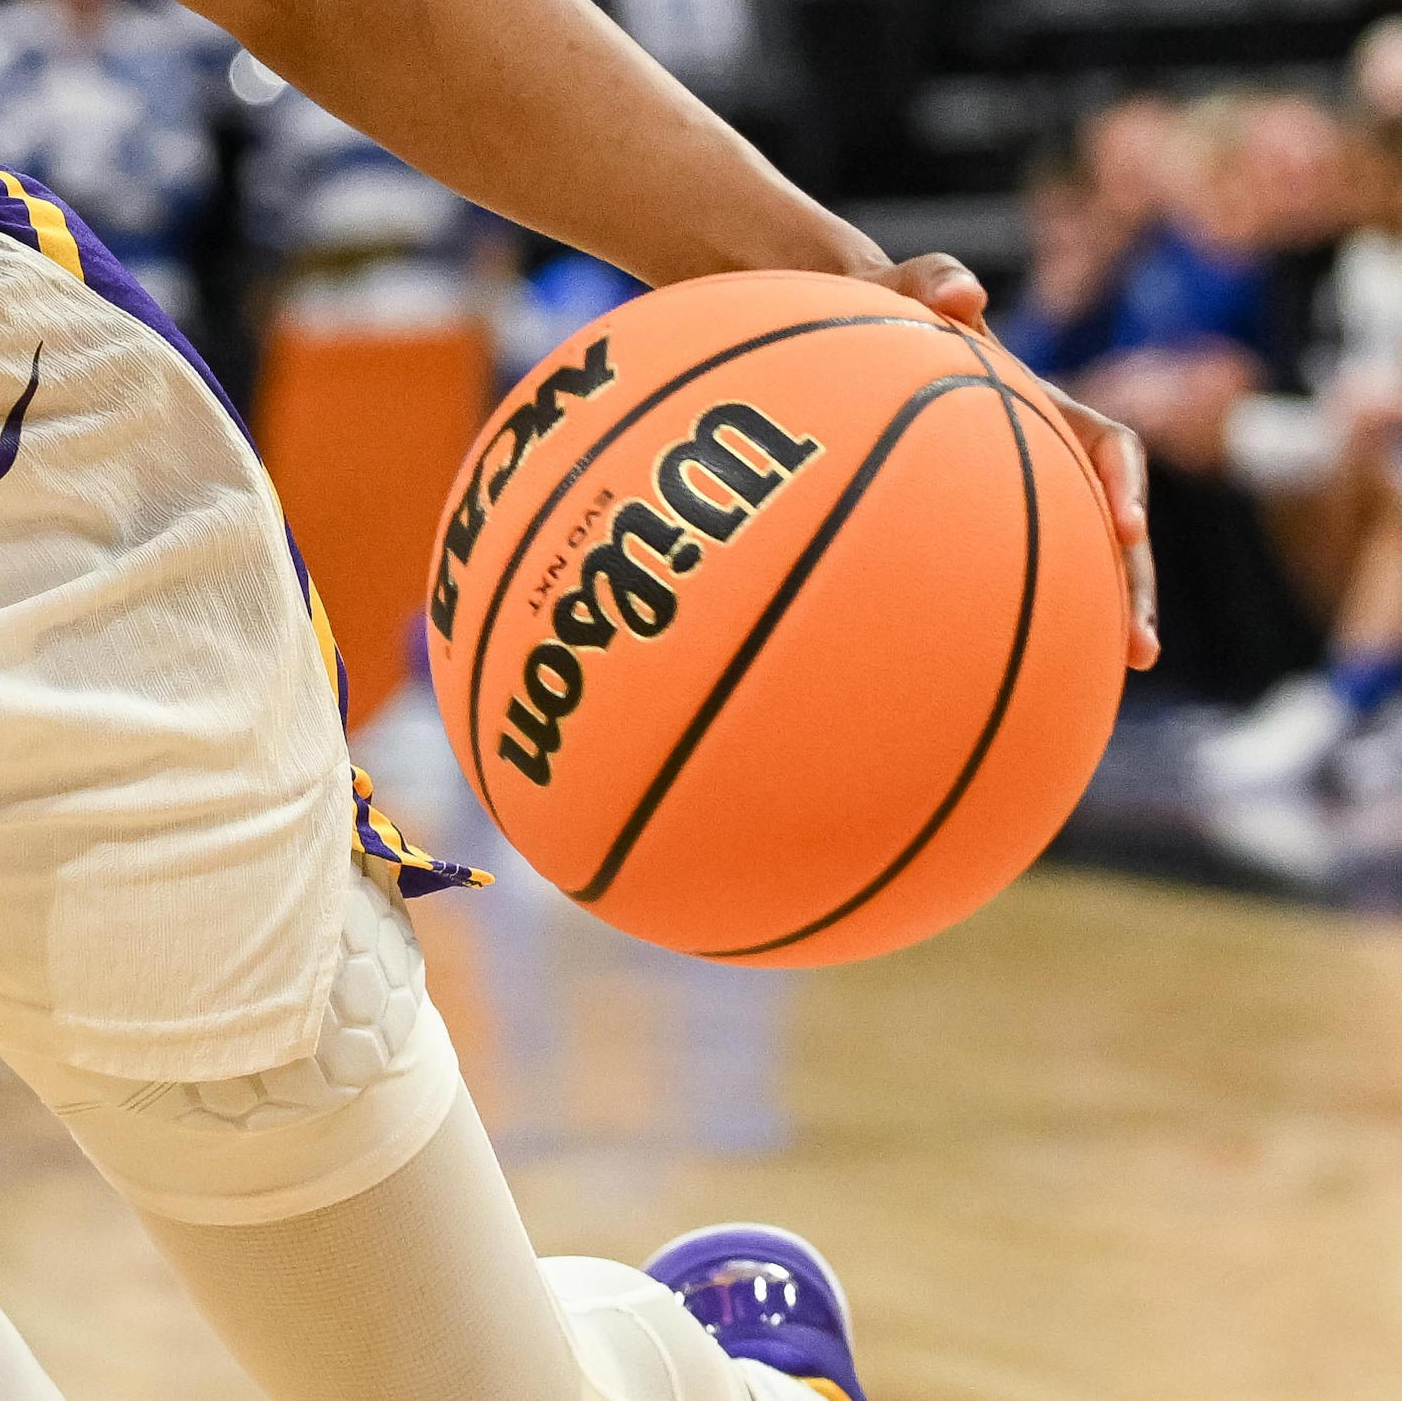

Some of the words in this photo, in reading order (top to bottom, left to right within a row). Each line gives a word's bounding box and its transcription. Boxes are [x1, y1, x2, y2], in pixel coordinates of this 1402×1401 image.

[430, 333, 617, 643] NCAA
[565, 486, 615, 549] EVO
[497, 401, 824, 788] Wilson
[527, 553, 568, 617] NXT
